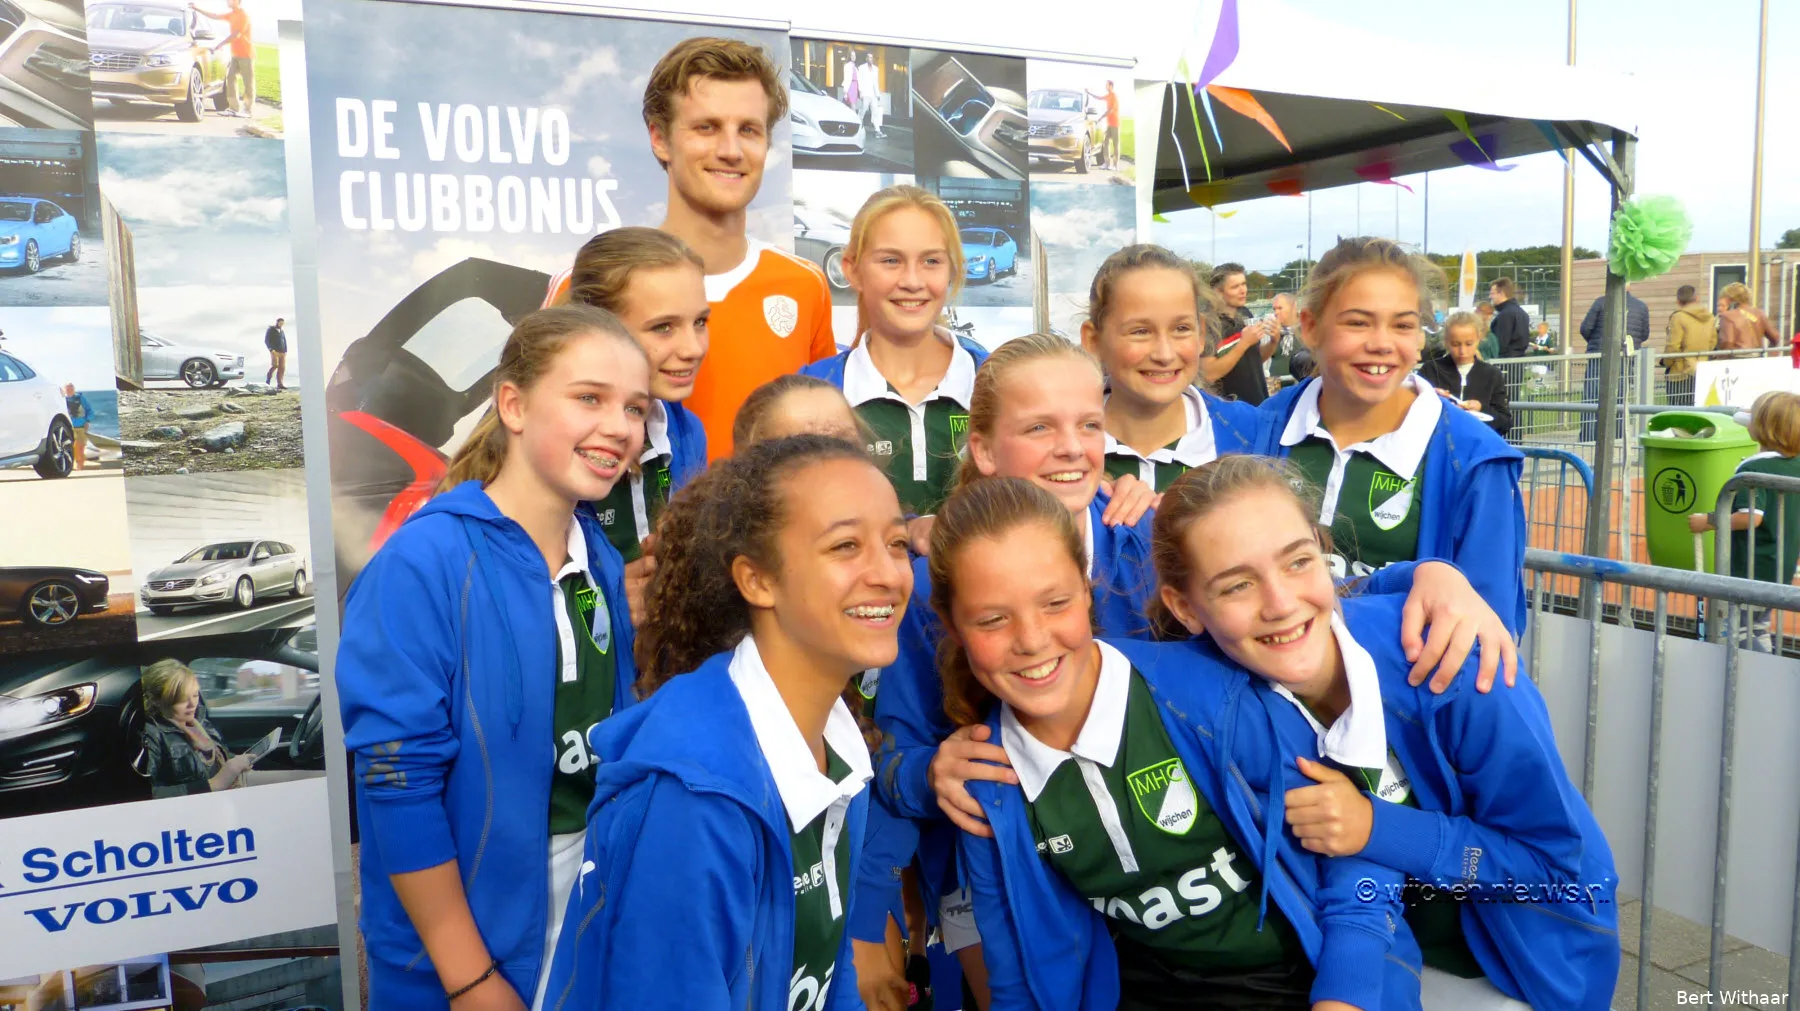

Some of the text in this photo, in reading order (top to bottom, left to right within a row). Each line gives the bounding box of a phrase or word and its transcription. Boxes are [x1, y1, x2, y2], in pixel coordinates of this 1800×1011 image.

[335, 97, 571, 166] DE VOLVO
[339, 170, 622, 235] CLUBBONUS
[1374, 475, 1413, 494] MHC
[1135, 763, 1184, 796] MHC
[1159, 807, 1193, 828] wijchen
[22, 827, 256, 884] Scholten
[1468, 847, 1483, 881] Reec
[24, 877, 259, 933] VOLVO
